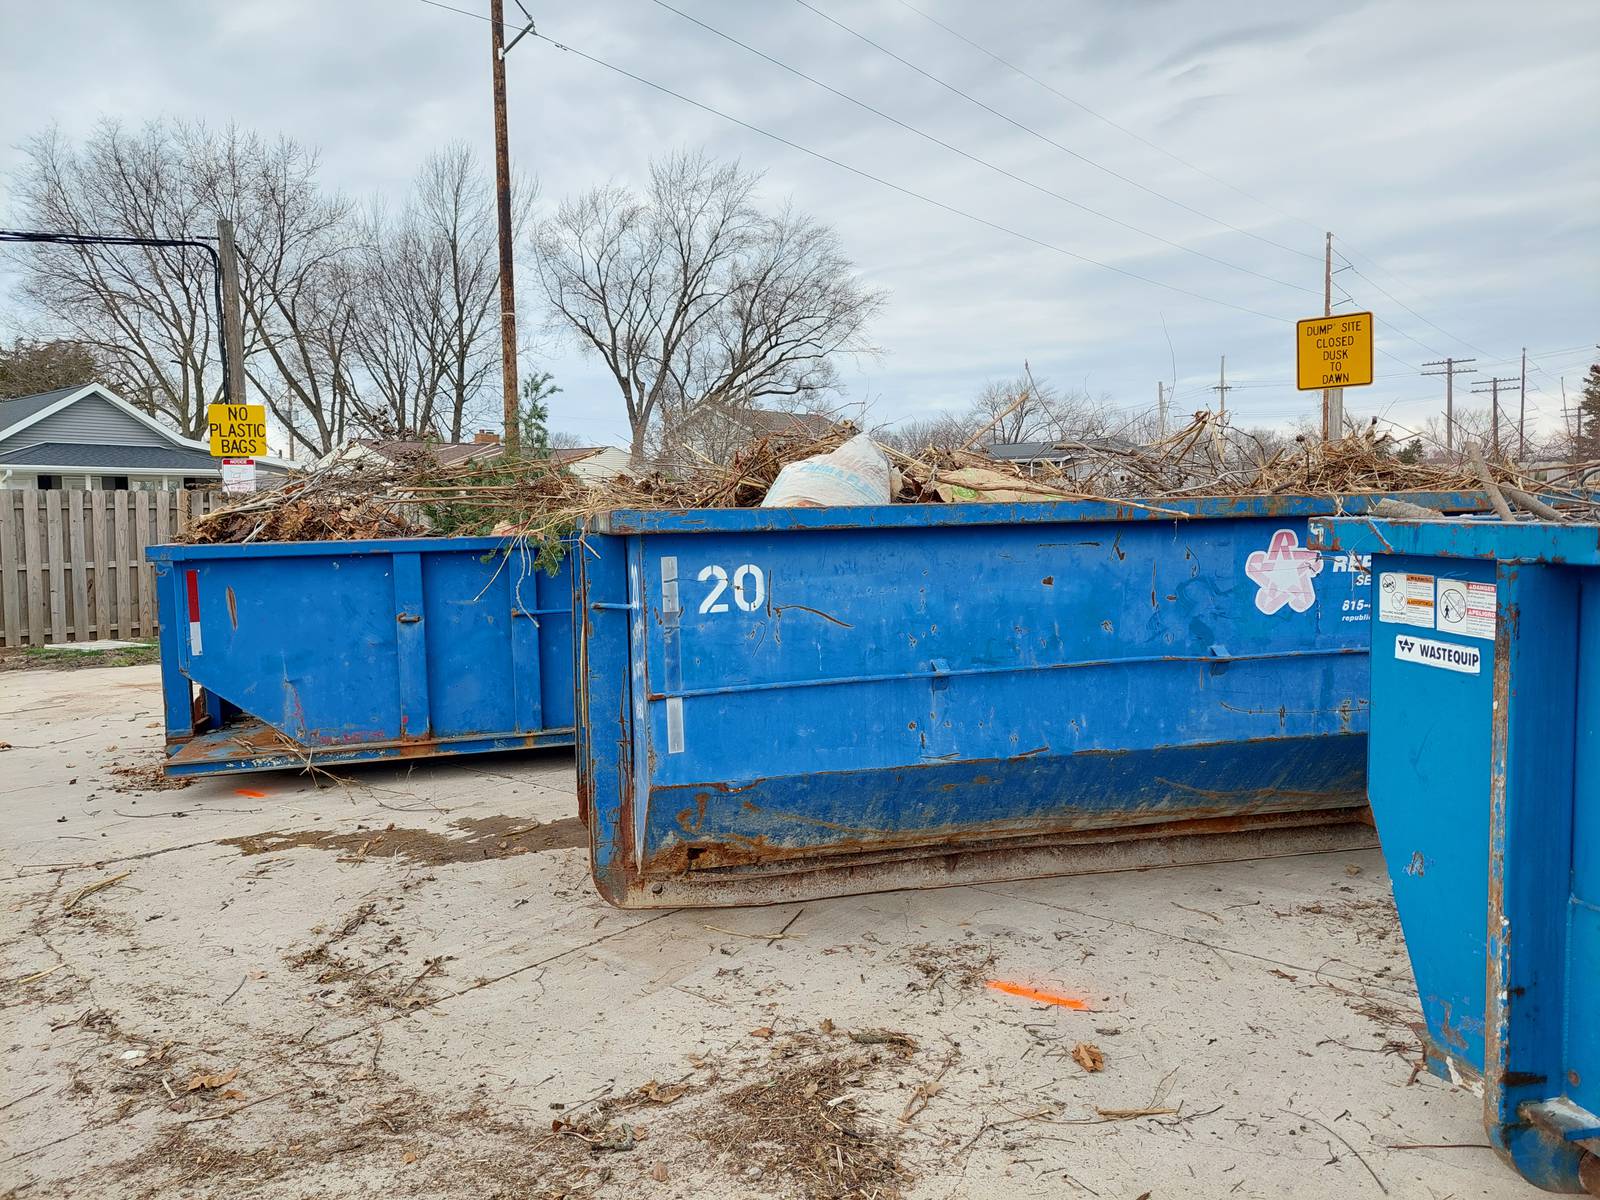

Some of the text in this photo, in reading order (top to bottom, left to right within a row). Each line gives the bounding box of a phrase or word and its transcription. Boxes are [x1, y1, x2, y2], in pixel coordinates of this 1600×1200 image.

[1306, 320, 1361, 336] DUMP SITE
[1316, 335, 1354, 349] CLOSED
[1323, 349, 1349, 361] DUSK
[1330, 361, 1342, 372] TO
[1322, 372, 1349, 385] DAWN
[227, 406, 248, 421] NO
[209, 423, 266, 438] PLASTIC
[221, 439, 257, 454] BAGS
[697, 564, 765, 614] 20
[1472, 584, 1495, 592] DANGER
[1472, 609, 1496, 618] PELIGRO
[1419, 643, 1479, 667] WASTEQUIP
